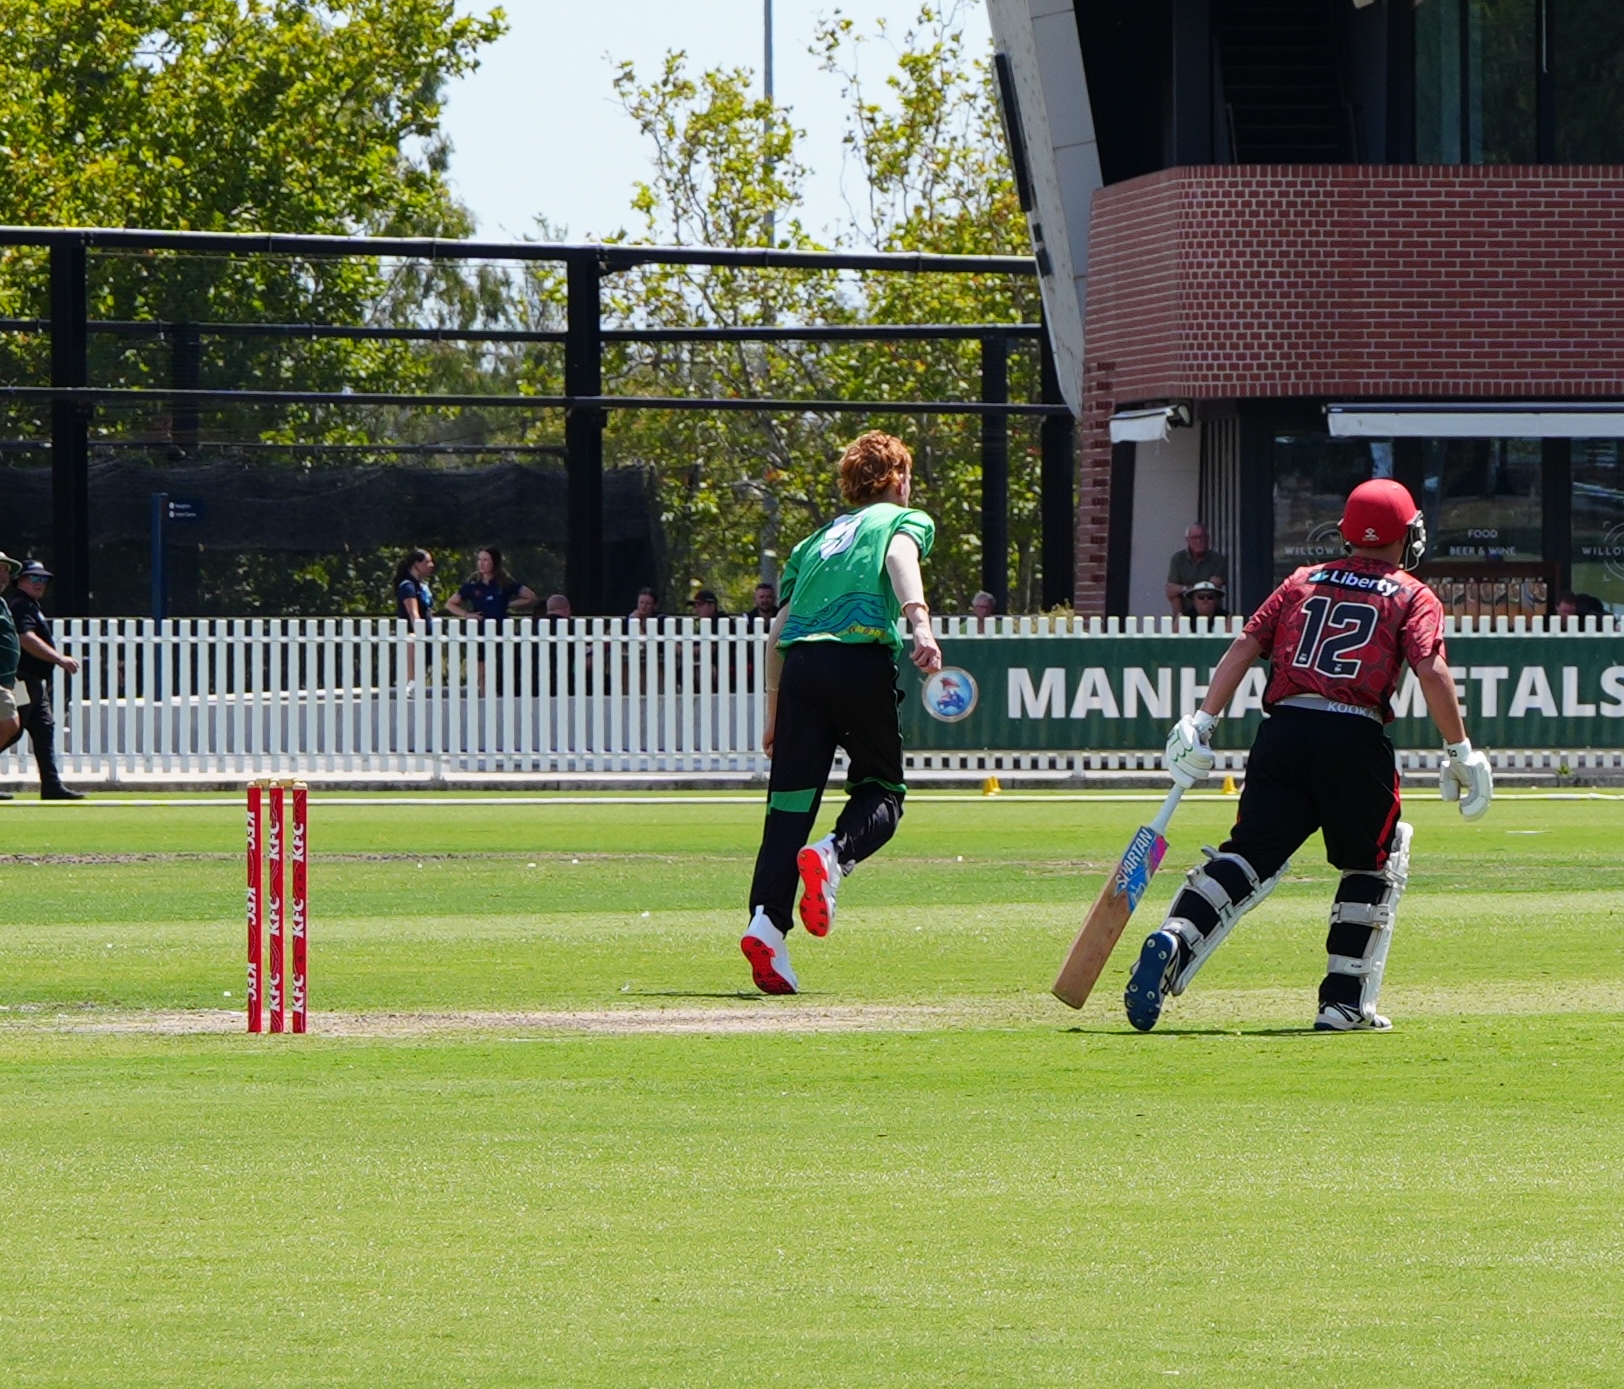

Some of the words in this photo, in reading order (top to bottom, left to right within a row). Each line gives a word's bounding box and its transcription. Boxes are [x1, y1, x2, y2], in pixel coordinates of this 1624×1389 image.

[1449, 546, 1475, 556] BEER
[1478, 546, 1486, 556] &
[1467, 529, 1498, 538] FOOD
[1329, 570, 1400, 598] Liberty
[1292, 595, 1378, 679] 12
[1007, 667, 1272, 719] MANHA
[247, 811, 256, 851] KFC
[269, 821, 280, 861] KFC
[293, 822, 304, 862] KFC
[1115, 828, 1153, 889] SPARTAN
[247, 887, 256, 926] KFC
[269, 897, 280, 936] KFC
[293, 898, 304, 939] KFC
[247, 962, 257, 1001] KFC
[269, 972, 280, 1012] KFC
[292, 974, 304, 1014] KFC
